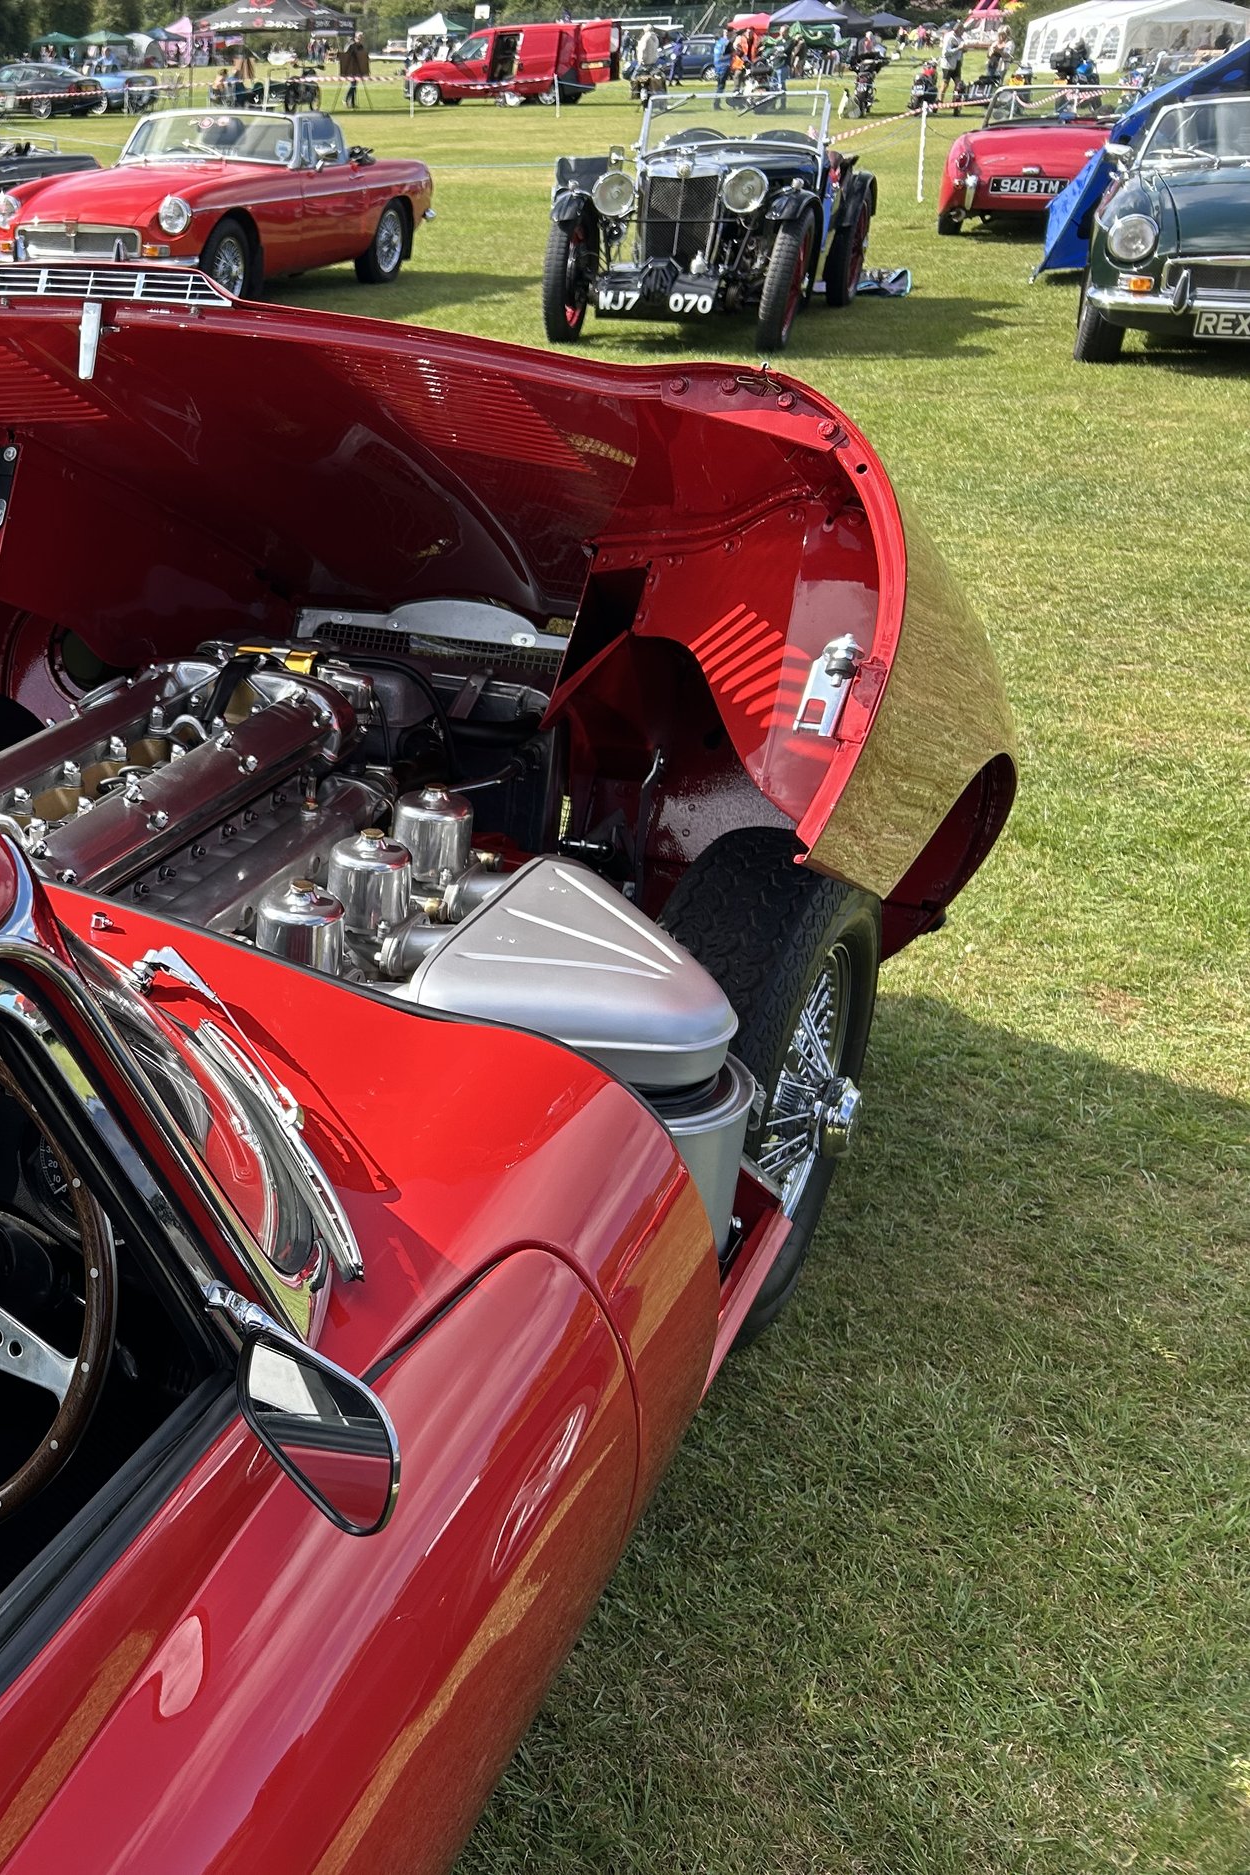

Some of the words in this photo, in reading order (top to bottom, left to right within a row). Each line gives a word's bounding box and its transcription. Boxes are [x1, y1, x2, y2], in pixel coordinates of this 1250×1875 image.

[999, 179, 1025, 193] 941
[1026, 179, 1060, 194] BTM
[669, 292, 713, 315] 070
[1198, 312, 1250, 336] REX
[47, 1159, 58, 1169] 20
[52, 1174, 61, 1183] 10
